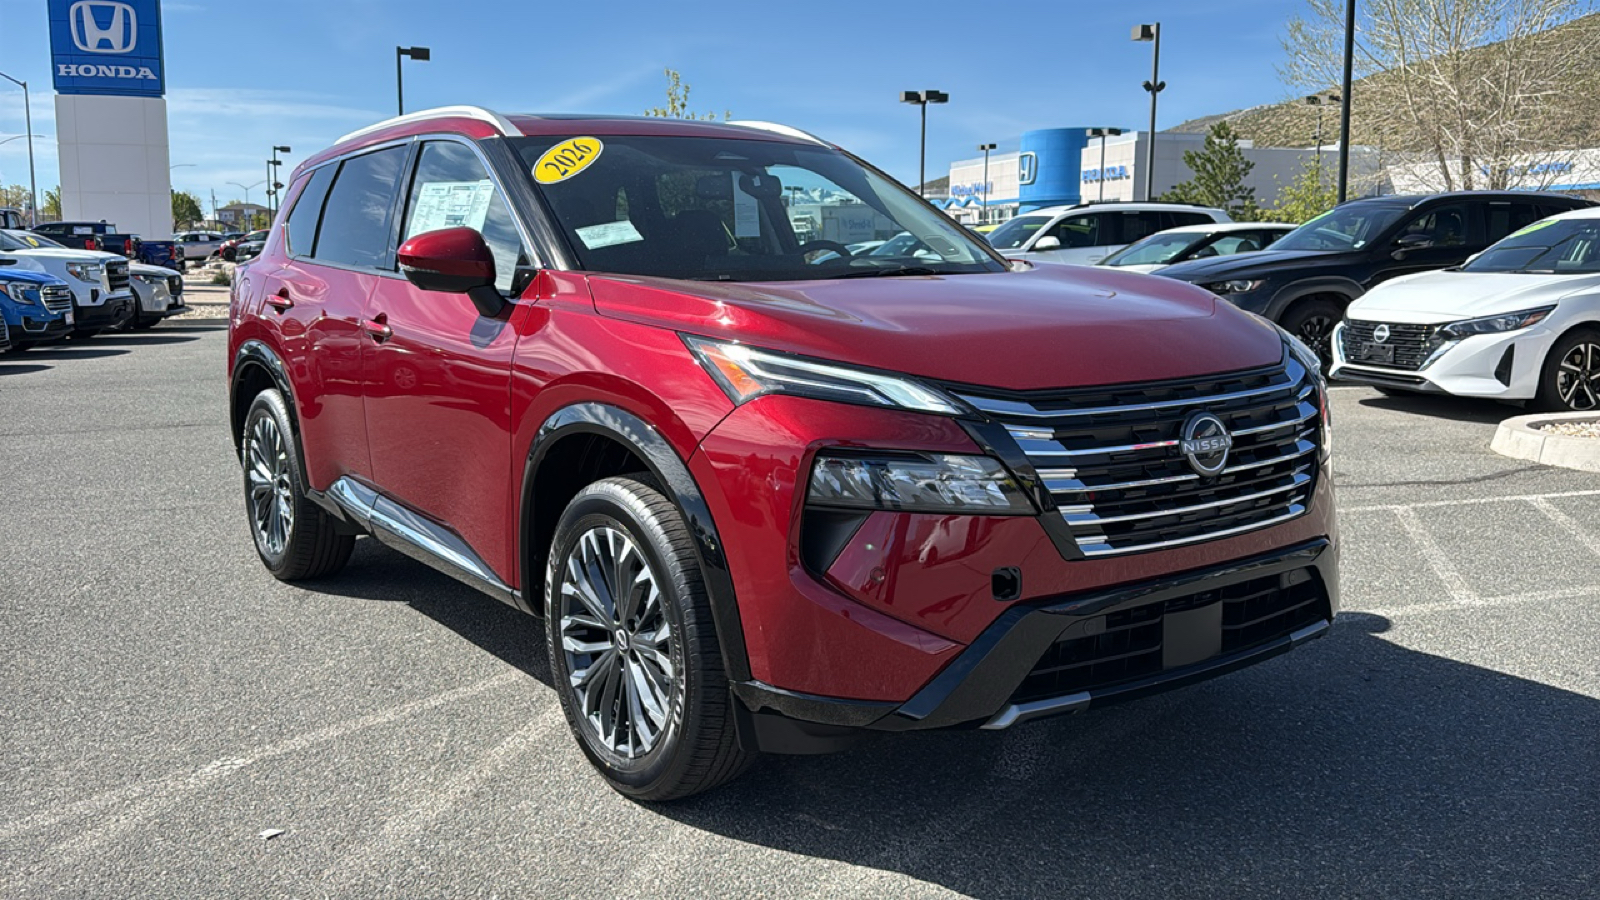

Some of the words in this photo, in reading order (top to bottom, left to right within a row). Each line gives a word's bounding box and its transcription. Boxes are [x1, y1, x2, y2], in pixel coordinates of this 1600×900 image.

[57, 64, 157, 80] HONDA
[545, 140, 592, 176] 2026
[1184, 436, 1232, 452] NISSAN
